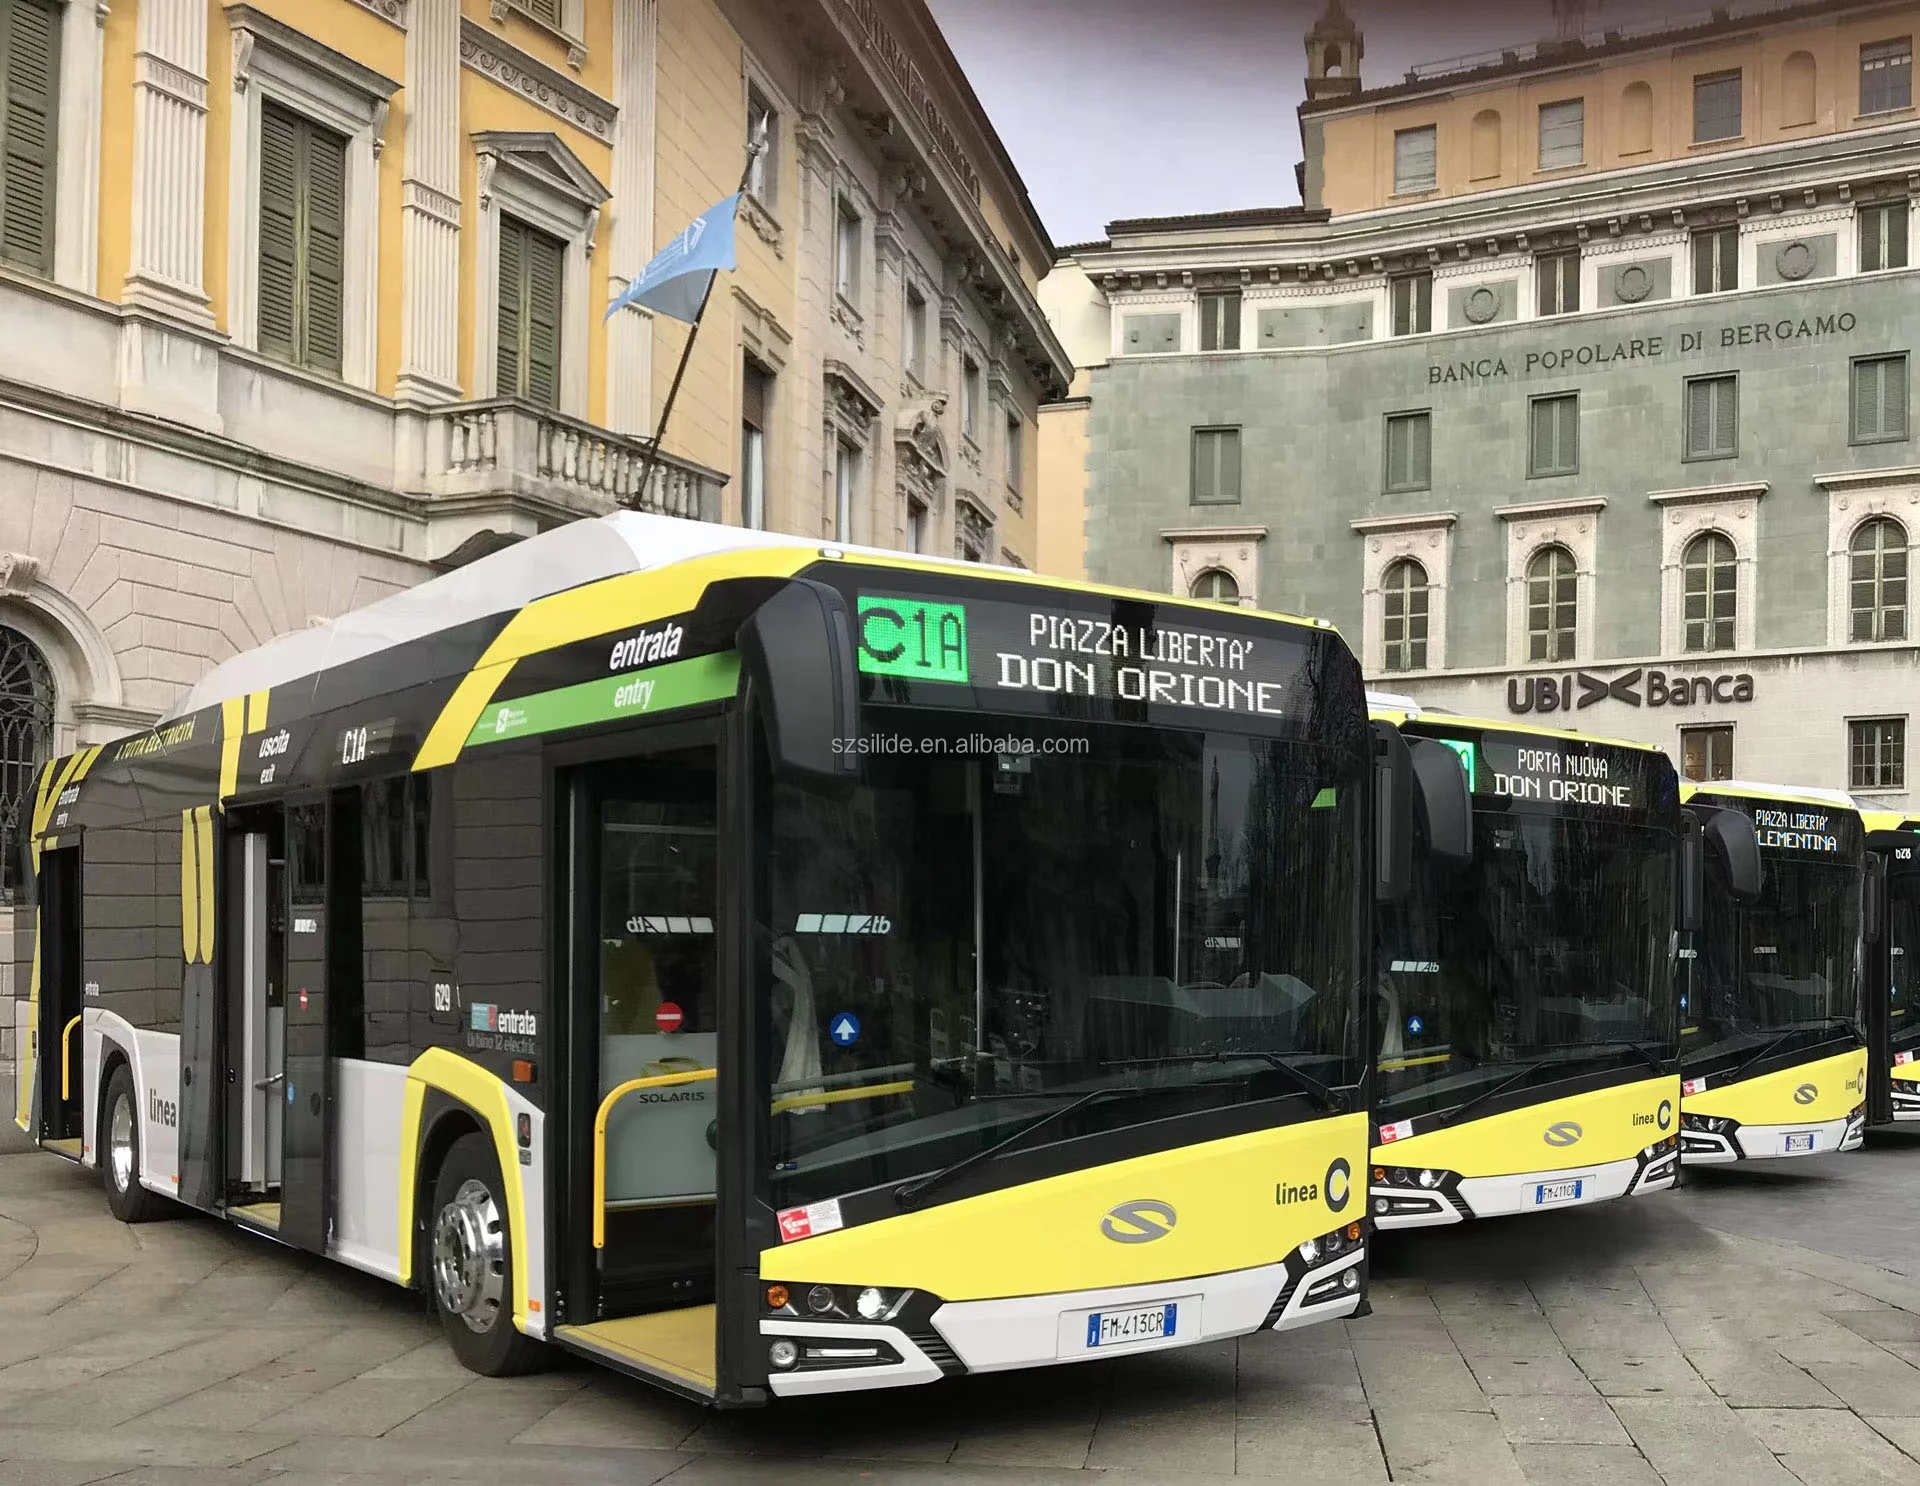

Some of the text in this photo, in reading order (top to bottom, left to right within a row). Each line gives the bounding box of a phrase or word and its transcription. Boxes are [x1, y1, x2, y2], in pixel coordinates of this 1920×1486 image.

[1428, 312, 1858, 385] BANCA POPOLARE DI BERGAMO
[608, 621, 685, 671] entrata
[858, 606, 963, 672] C1A
[1030, 613, 1130, 657] PIAZZA
[613, 677, 656, 710] entry
[996, 652, 1283, 715] DON ORIONE
[1507, 670, 1755, 714] UBI Banca
[258, 727, 291, 759] uscita
[342, 726, 367, 765] C1A
[260, 763, 276, 785] exit
[1517, 748, 1608, 779] PORTA NUOVA
[1493, 773, 1631, 808] DON ORIONE
[1755, 809, 1787, 828] PIAZZA
[1755, 830, 1837, 852] LEMENTINA
[434, 983, 451, 1012] 629
[497, 1008, 537, 1036] entrata
[149, 1088, 177, 1128] linea
[638, 1090, 705, 1104] SOLARIS
[1632, 1112, 1655, 1126] linea
[1275, 1182, 1318, 1206] linea
